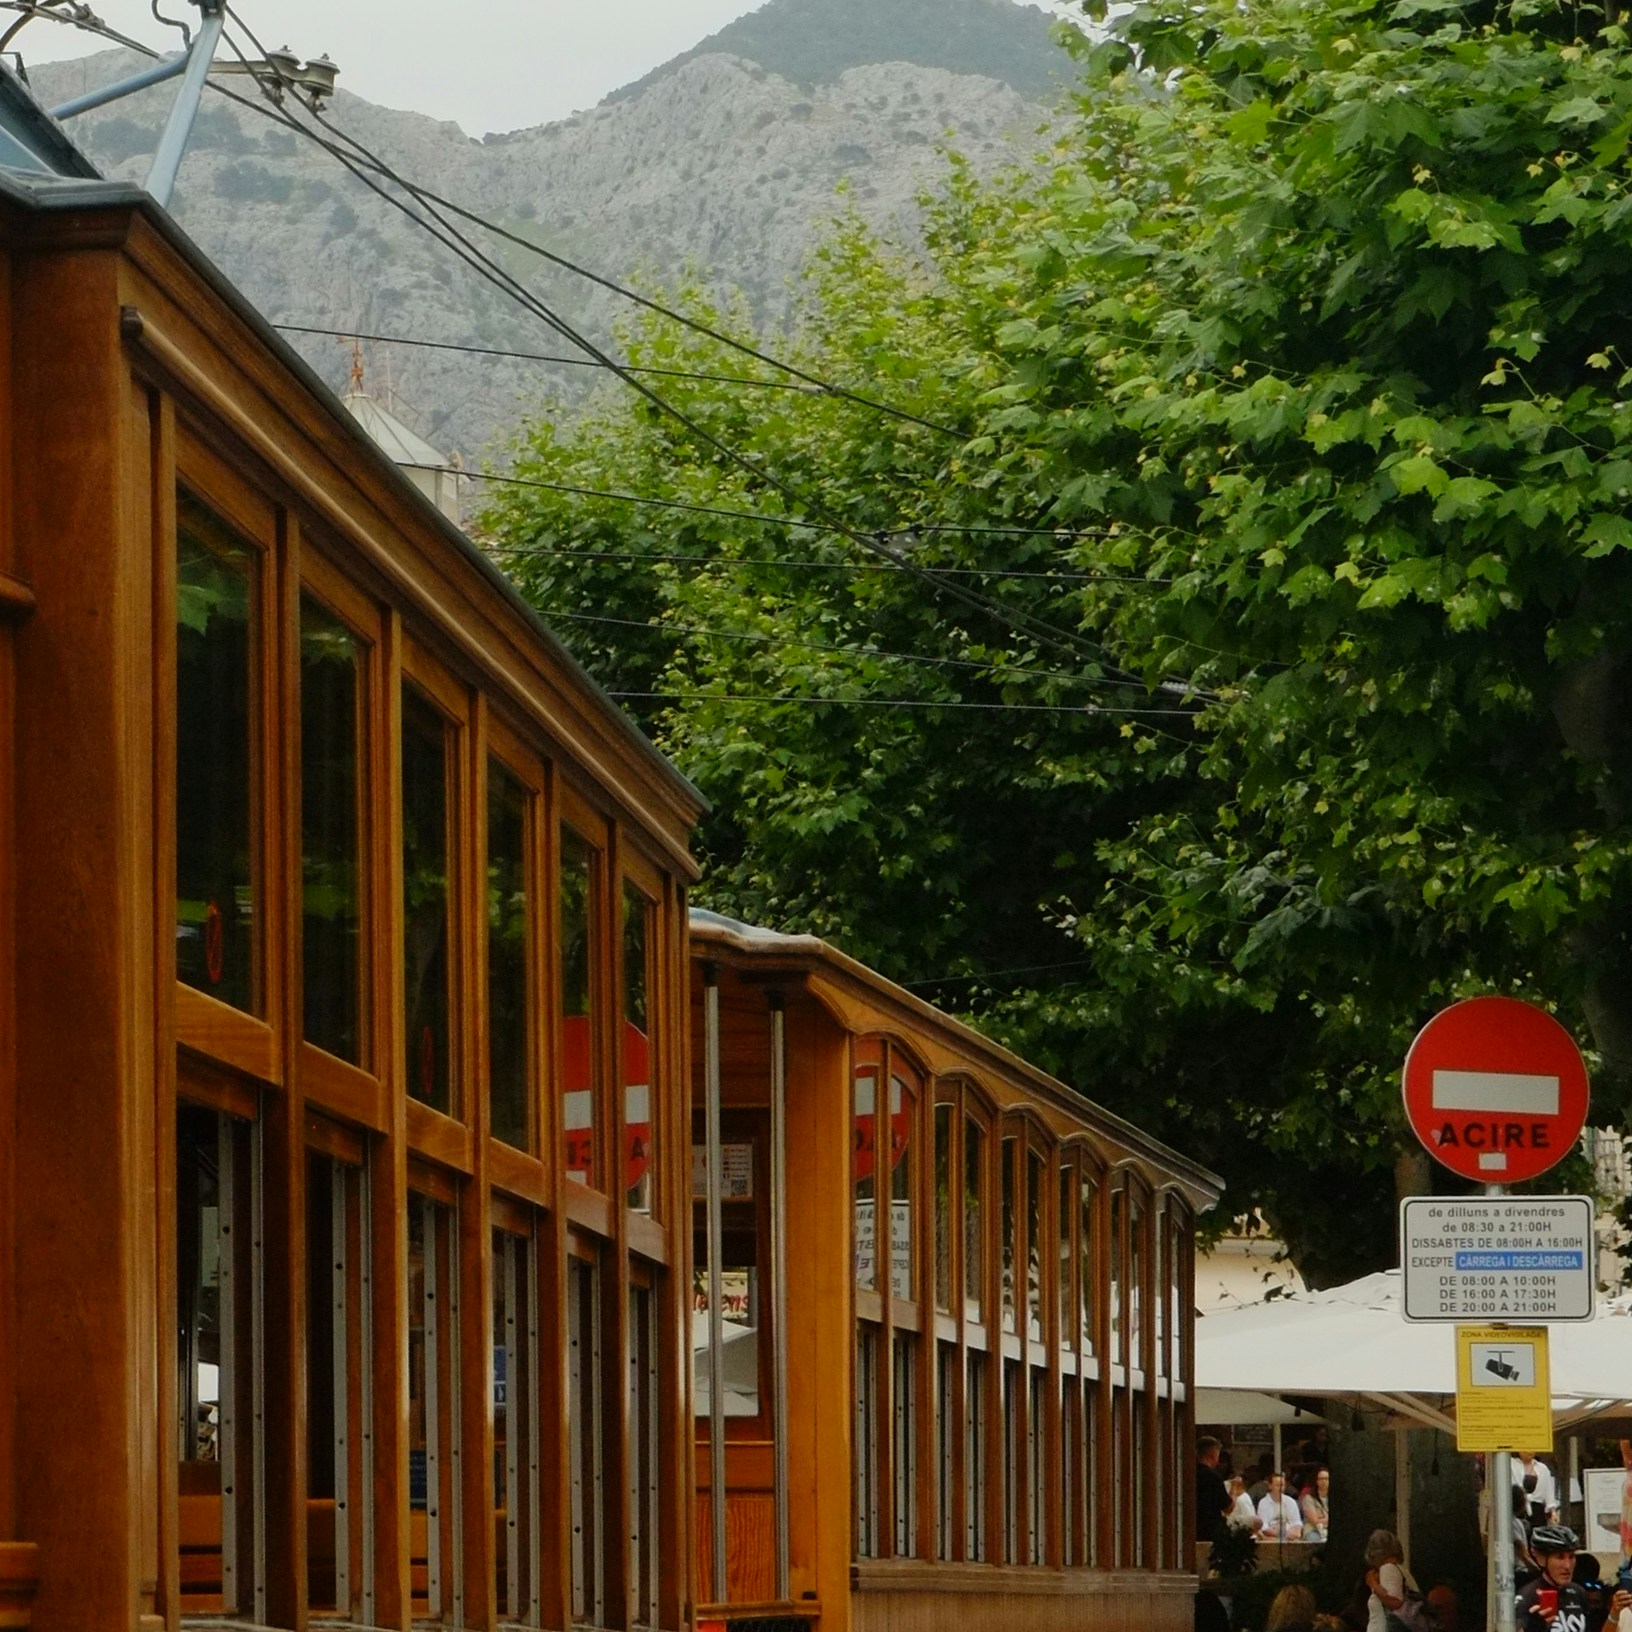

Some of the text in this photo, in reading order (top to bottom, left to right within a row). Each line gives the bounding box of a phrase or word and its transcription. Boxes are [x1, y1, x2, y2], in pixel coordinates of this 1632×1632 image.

[1438, 1122, 1550, 1148] ACIRE
[1428, 1206, 1565, 1218] de dilluns a divendres
[1442, 1221, 1552, 1232] de 08:30 a 21:00H
[1411, 1237, 1583, 1248] DISSABTES DE 08:00H A 16:00H
[1411, 1256, 1454, 1268] EXCEPTE
[1439, 1275, 1556, 1286] DE 08:00 A 10:00H
[1439, 1289, 1556, 1299] DE 16:00 A 17:30H
[1439, 1302, 1556, 1312] DE 20:00 A 21:00H
